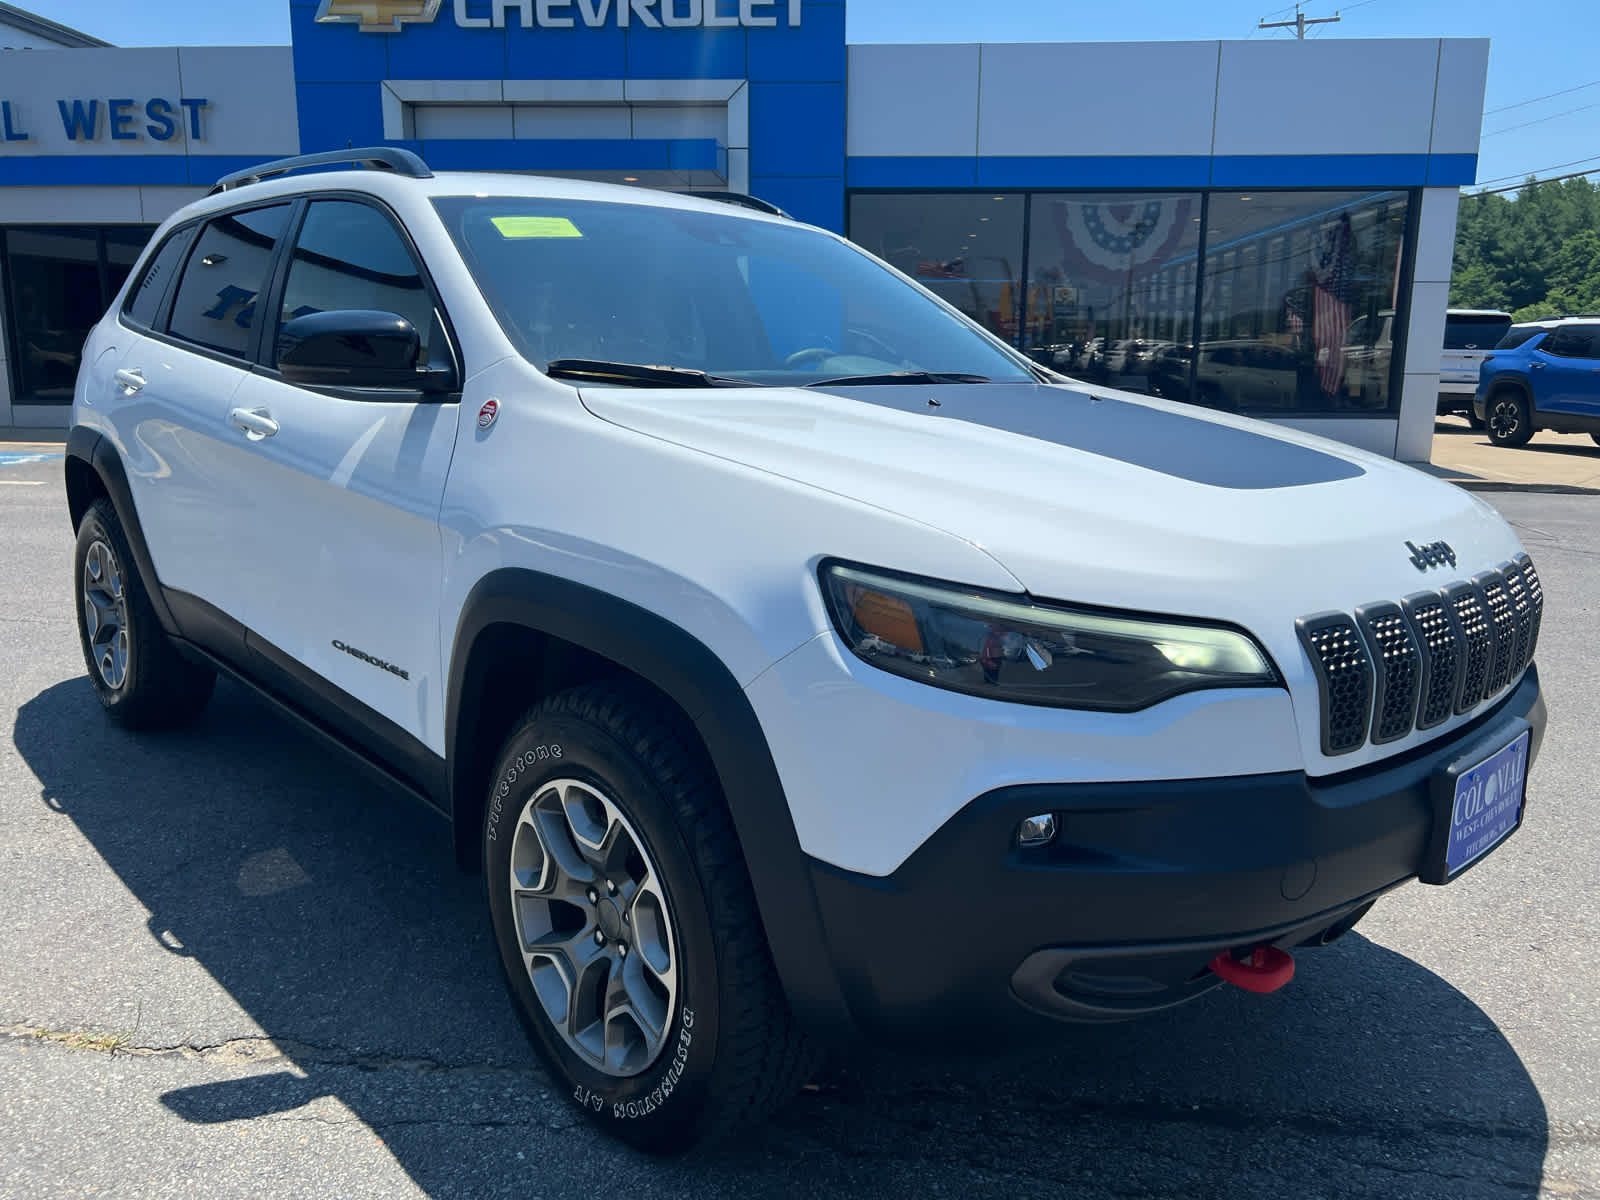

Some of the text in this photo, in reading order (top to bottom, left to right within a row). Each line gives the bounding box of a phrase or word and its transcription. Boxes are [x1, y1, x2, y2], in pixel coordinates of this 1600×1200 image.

[0, 97, 209, 142] L WEST
[1404, 540, 1457, 573] Jeep
[331, 639, 410, 681] CHEROKEE
[573, 1007, 695, 1119] DESTINATION A/T
